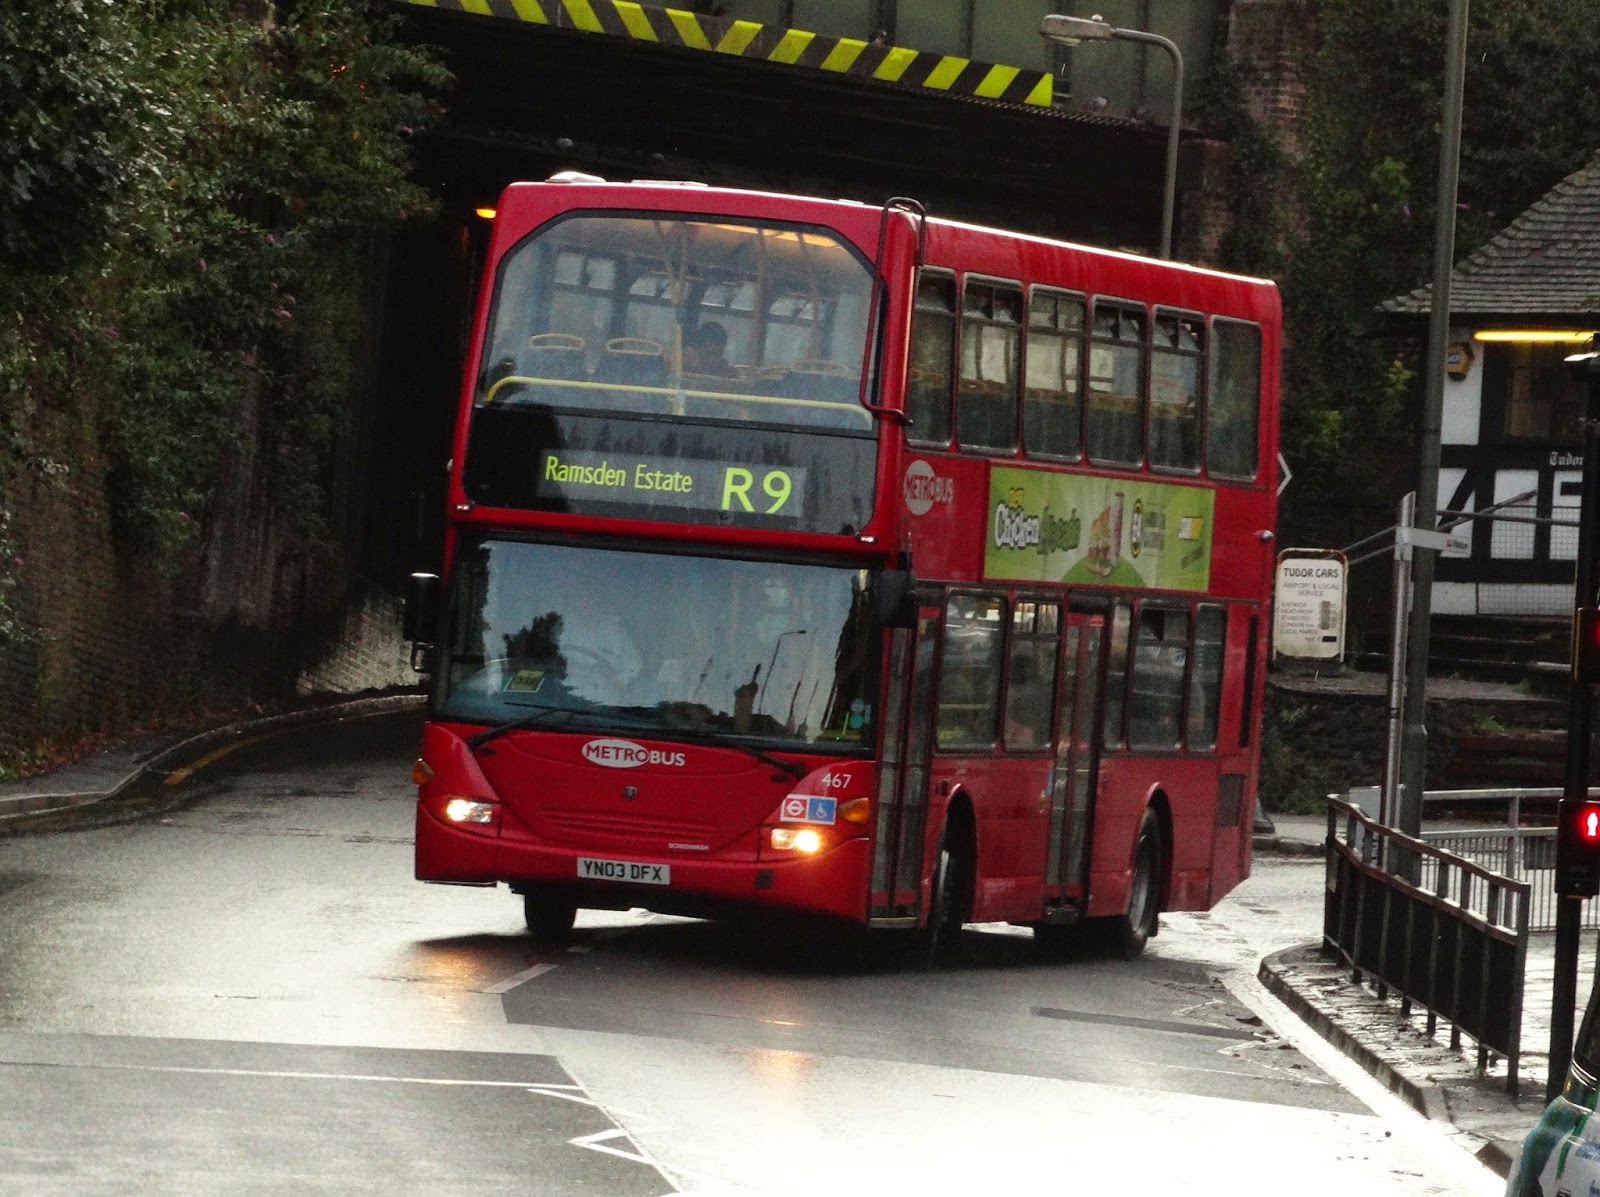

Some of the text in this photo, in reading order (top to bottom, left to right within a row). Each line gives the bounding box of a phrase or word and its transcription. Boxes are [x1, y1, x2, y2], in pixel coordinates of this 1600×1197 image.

[1550, 451, 1584, 466] Tudor
[545, 456, 627, 486] Ramsden
[634, 464, 693, 493] Estate
[1283, 568, 1339, 578] TUDOR CARS
[585, 743, 686, 767] METROBUS
[822, 772, 852, 788] 467
[583, 859, 662, 881] YN03 DFX
